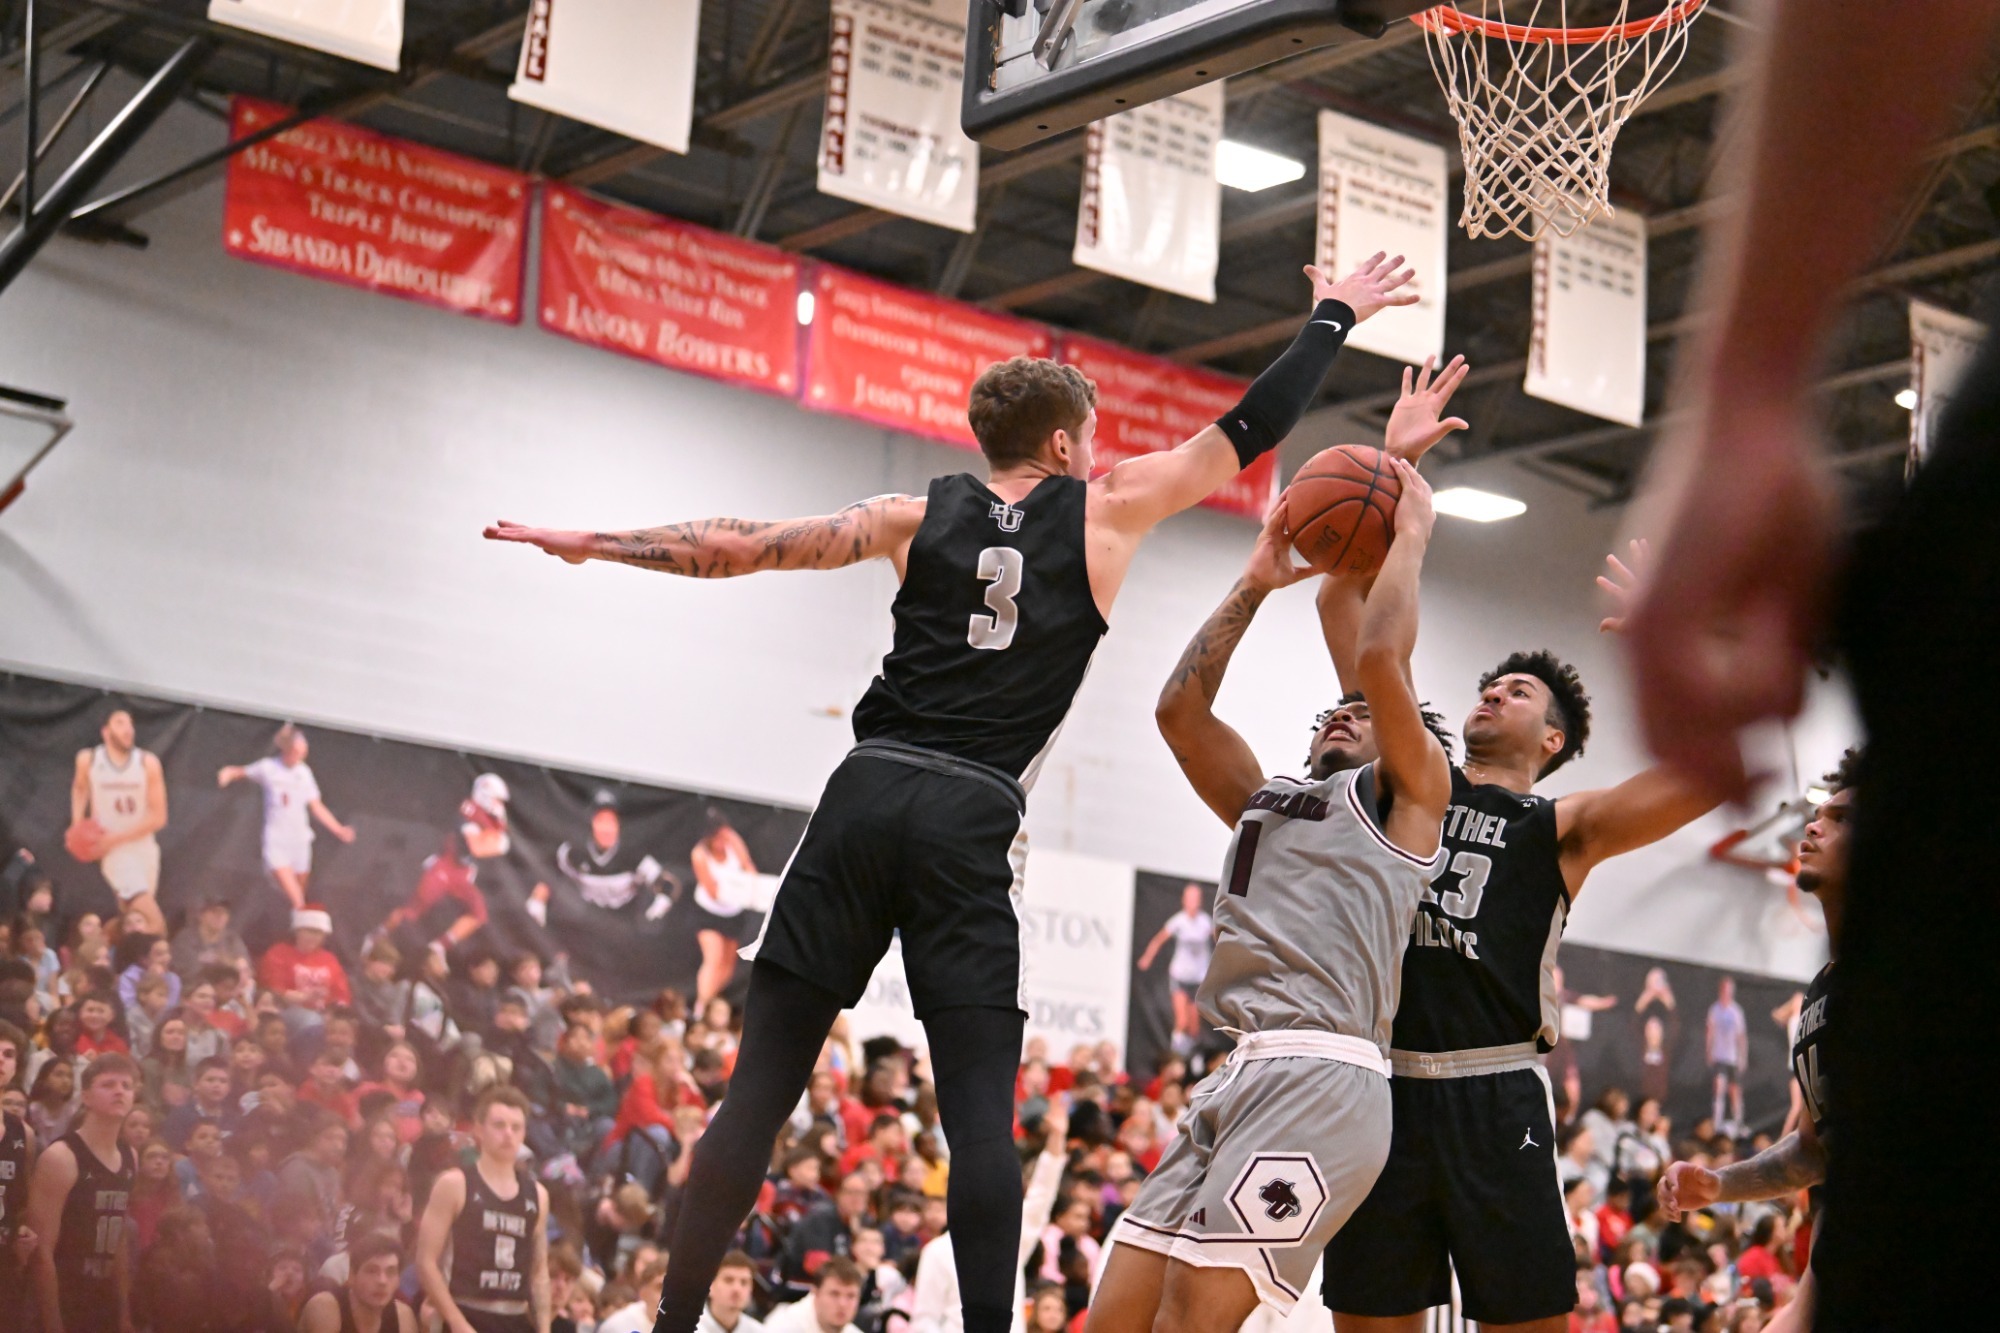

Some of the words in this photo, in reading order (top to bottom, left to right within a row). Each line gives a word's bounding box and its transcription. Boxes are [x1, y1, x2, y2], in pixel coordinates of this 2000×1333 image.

[967, 546, 1024, 651] 3
[1443, 803, 1508, 849] THEL
[1227, 819, 1264, 898] 1
[1410, 910, 1480, 960] ILOTS
